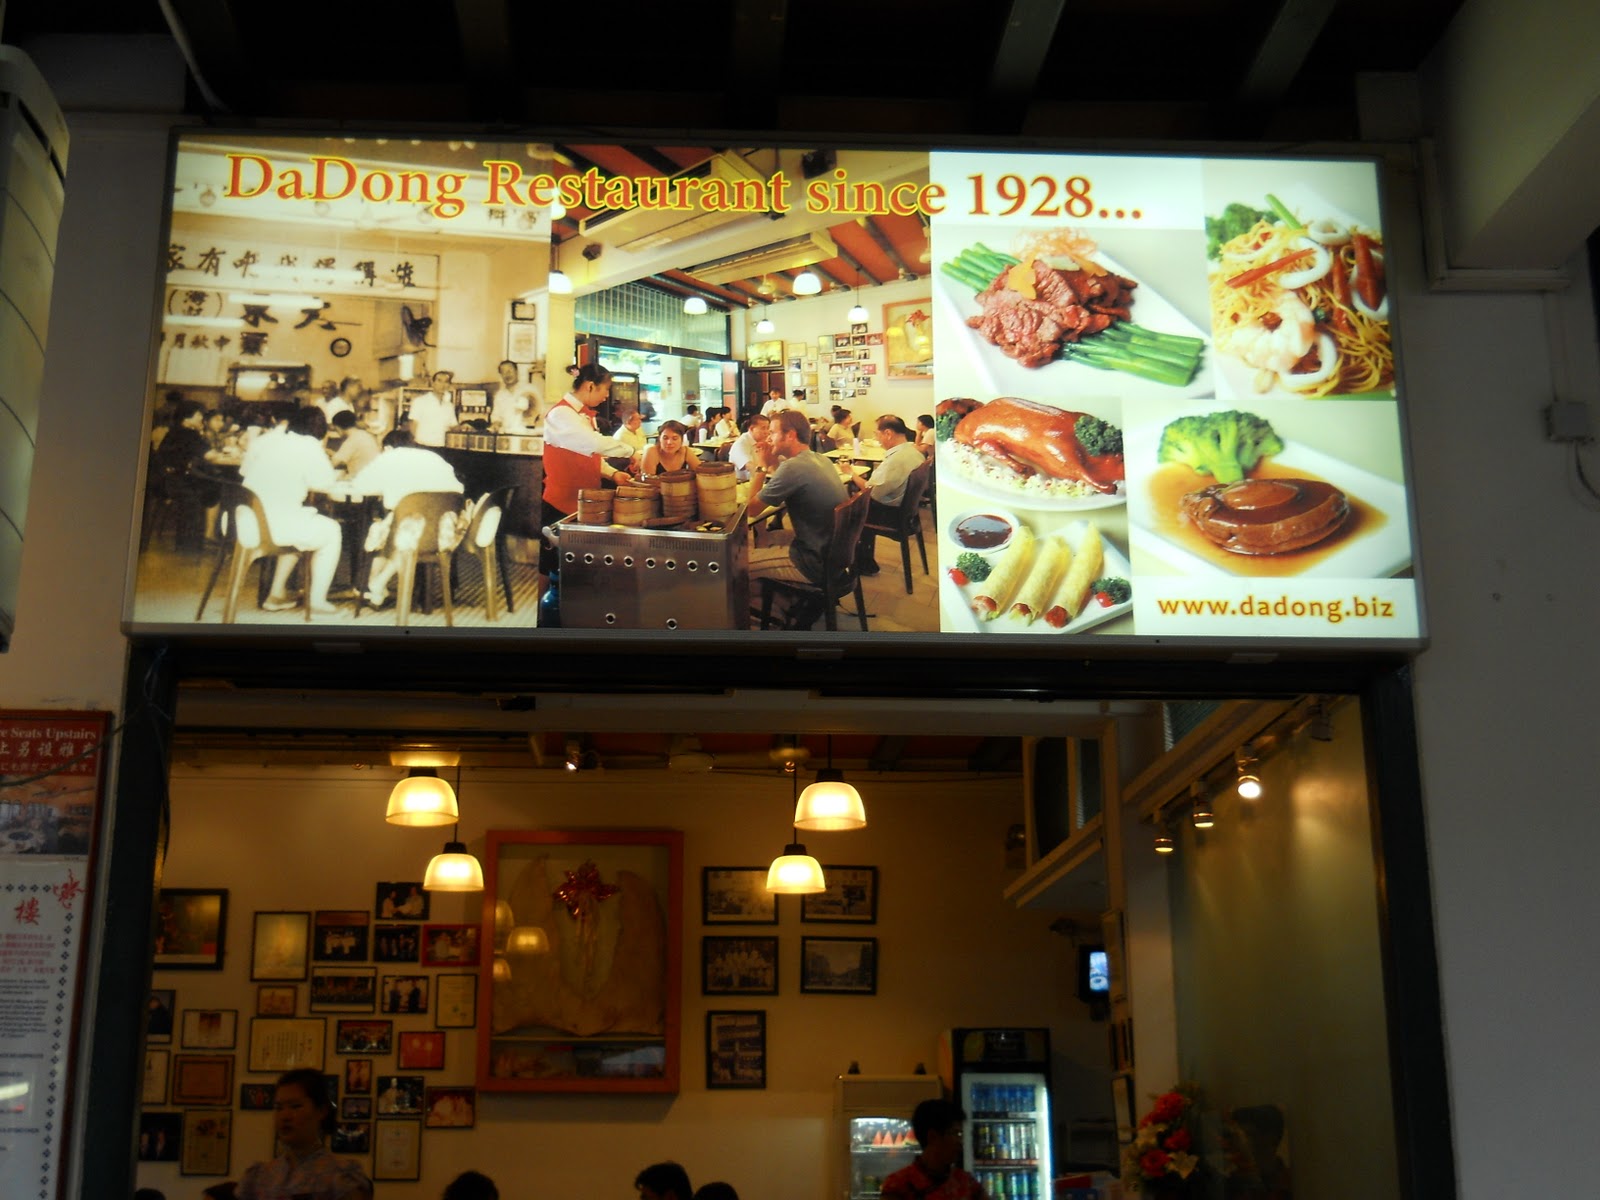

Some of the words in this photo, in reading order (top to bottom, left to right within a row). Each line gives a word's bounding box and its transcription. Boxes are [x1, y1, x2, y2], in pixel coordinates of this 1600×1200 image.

[226, 153, 468, 219] DaDong
[483, 160, 791, 213] Restaurant
[805, 168, 946, 216] since
[967, 173, 1143, 218] 1928...
[1158, 594, 1394, 623] www.dadong.biz
[10, 727, 42, 739] Seats
[46, 727, 97, 741] Upstairs
